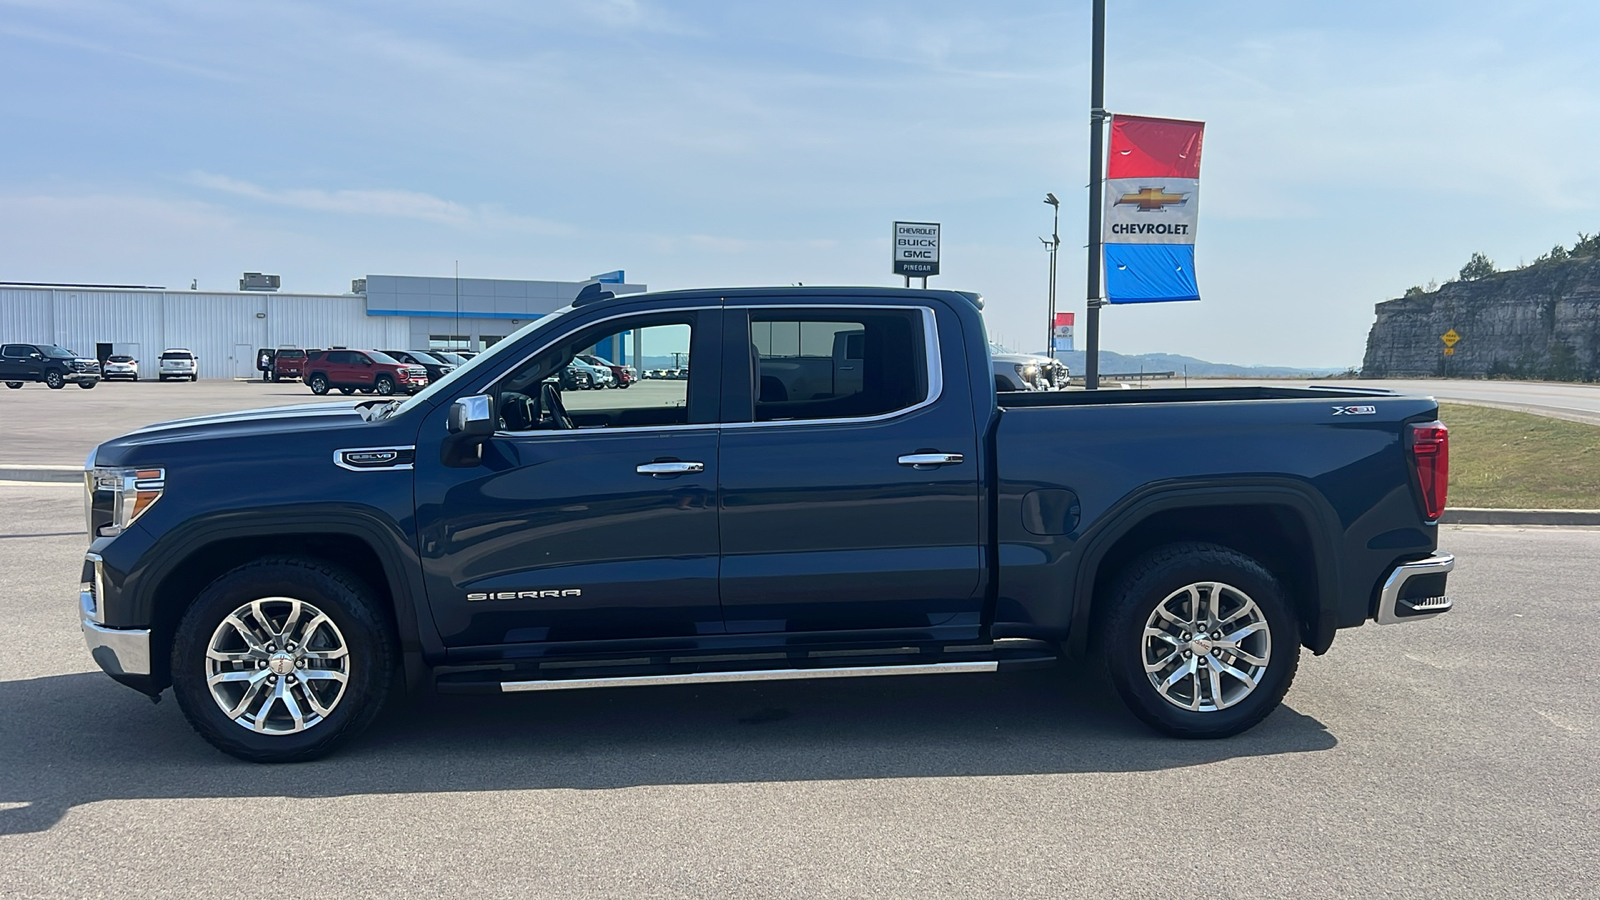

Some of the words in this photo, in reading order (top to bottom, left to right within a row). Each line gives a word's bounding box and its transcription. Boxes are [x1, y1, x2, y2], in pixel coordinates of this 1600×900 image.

[899, 227, 937, 235] CHEVROLET
[1111, 223, 1188, 235] CHEVROLET
[898, 239, 936, 247] BUICK
[903, 250, 931, 258] GMC
[467, 589, 581, 601] SIERRA
